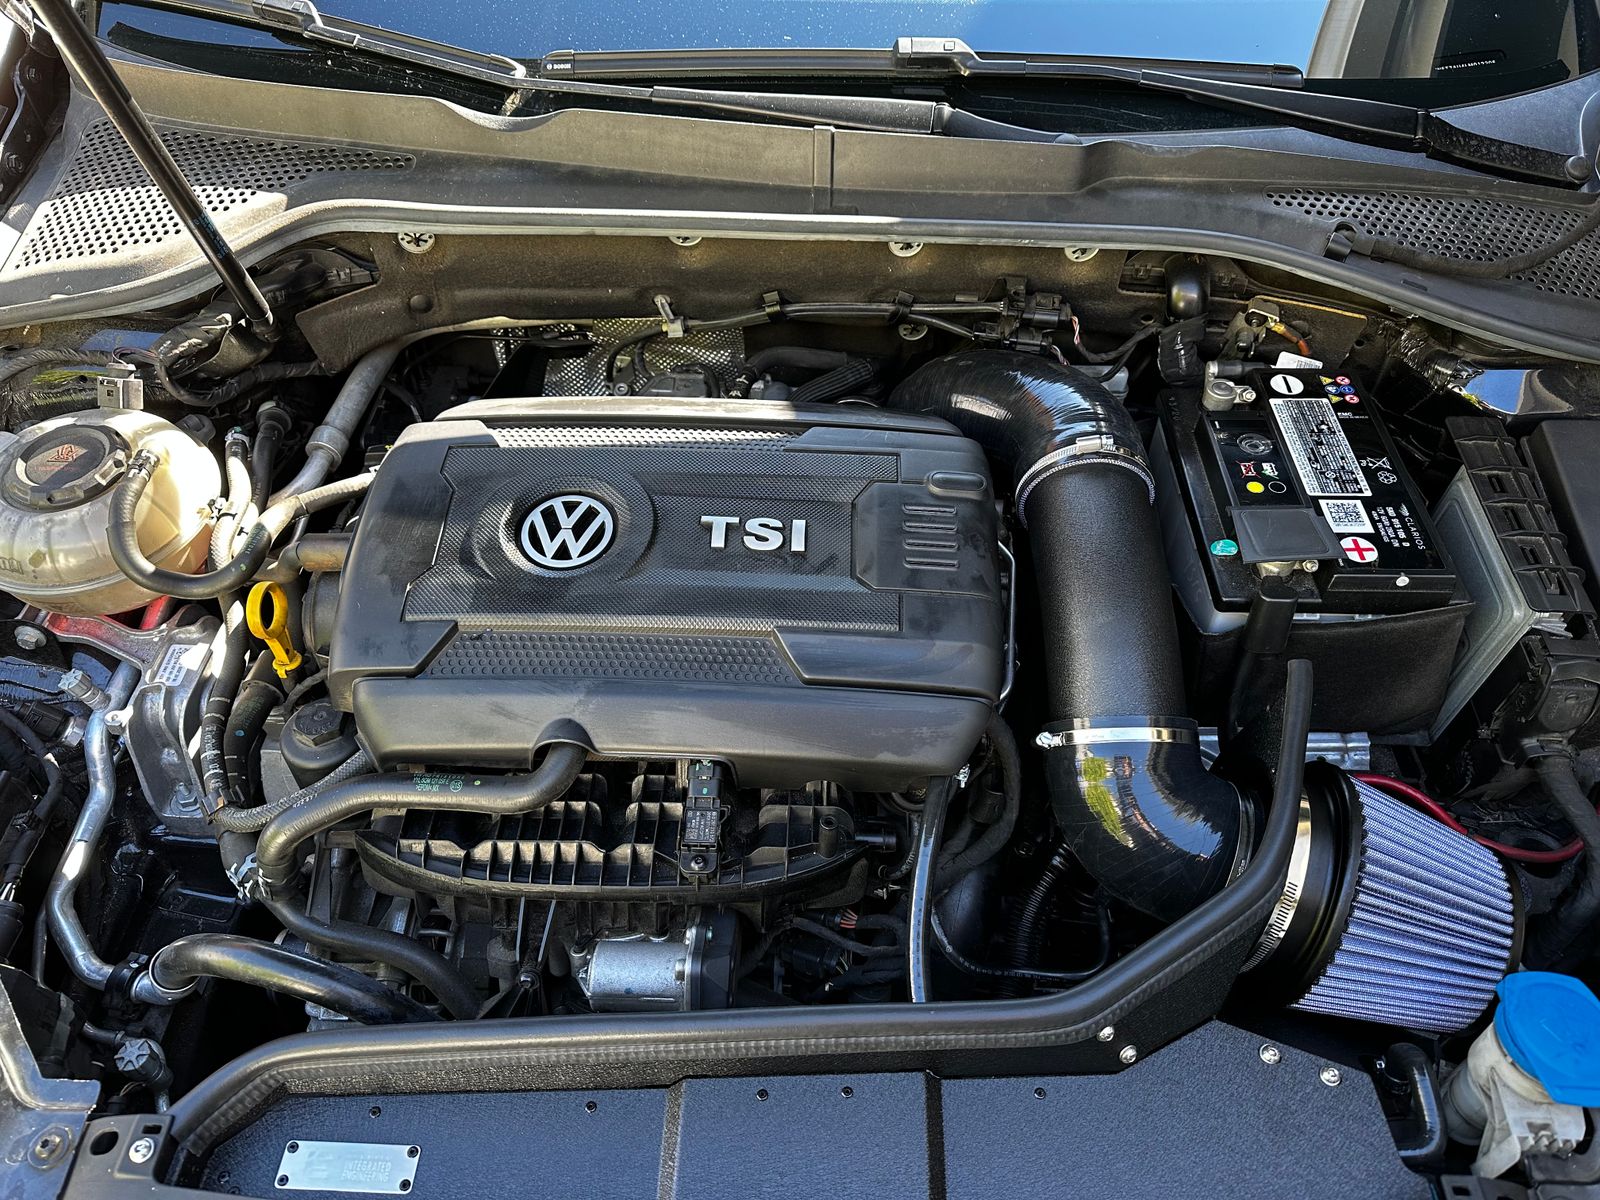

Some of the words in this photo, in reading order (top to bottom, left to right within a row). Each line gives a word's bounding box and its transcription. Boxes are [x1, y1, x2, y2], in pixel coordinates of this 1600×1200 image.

[700, 515, 807, 552] TSI
[1405, 516, 1426, 550] CLARIOS
[342, 1170, 390, 1182] ENGINEERING
[344, 1160, 392, 1172] INTEGRATED
